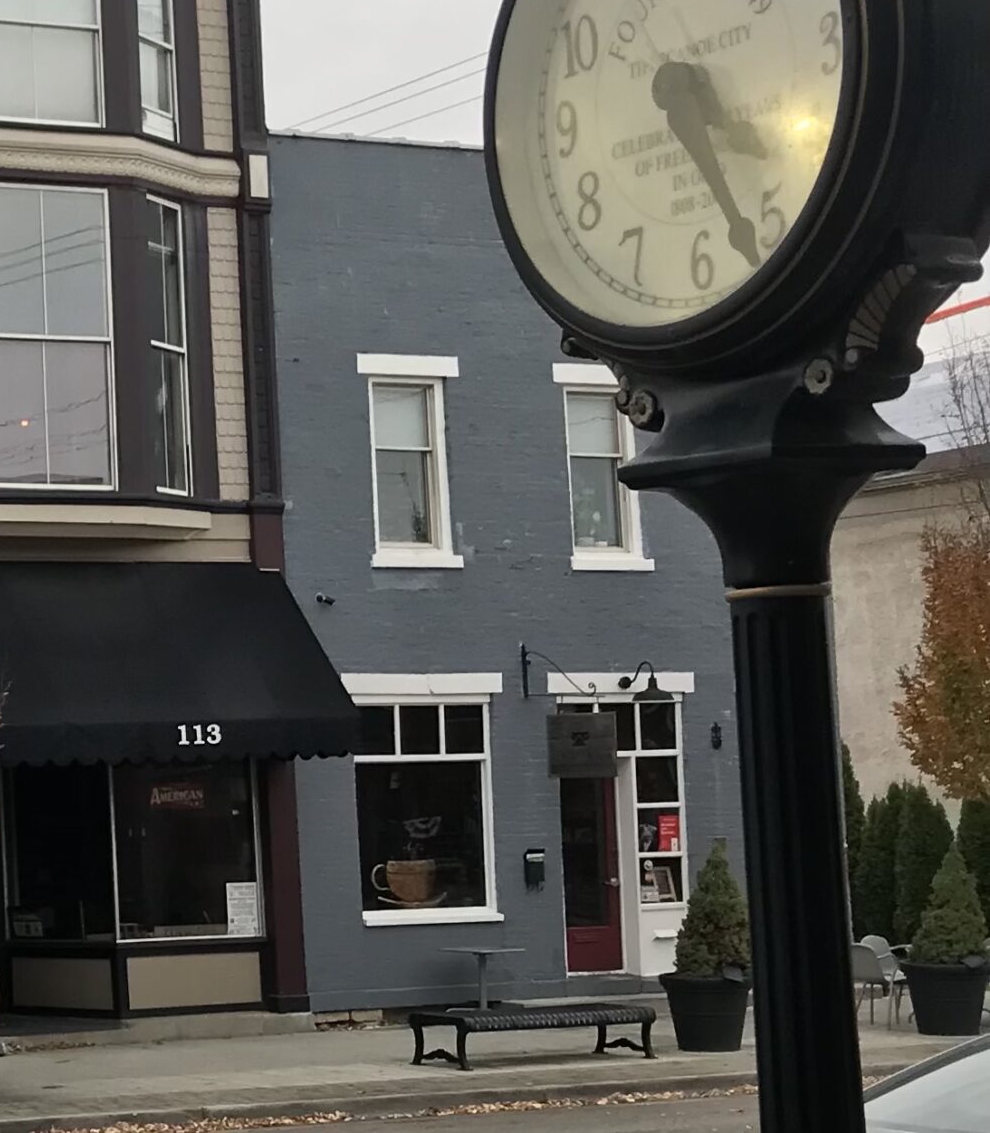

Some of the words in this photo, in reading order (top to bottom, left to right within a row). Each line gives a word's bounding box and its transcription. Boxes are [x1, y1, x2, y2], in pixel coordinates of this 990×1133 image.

[561, 15, 598, 79] 10
[719, 22, 752, 50] CITY
[819, 11, 841, 76] 3
[556, 100, 577, 158] 9
[577, 171, 602, 231] 8
[760, 181, 786, 249] 5
[618, 227, 643, 287] 7
[691, 230, 714, 290] 6
[177, 724, 222, 745] 113
[150, 786, 203, 805] AMERICAN
